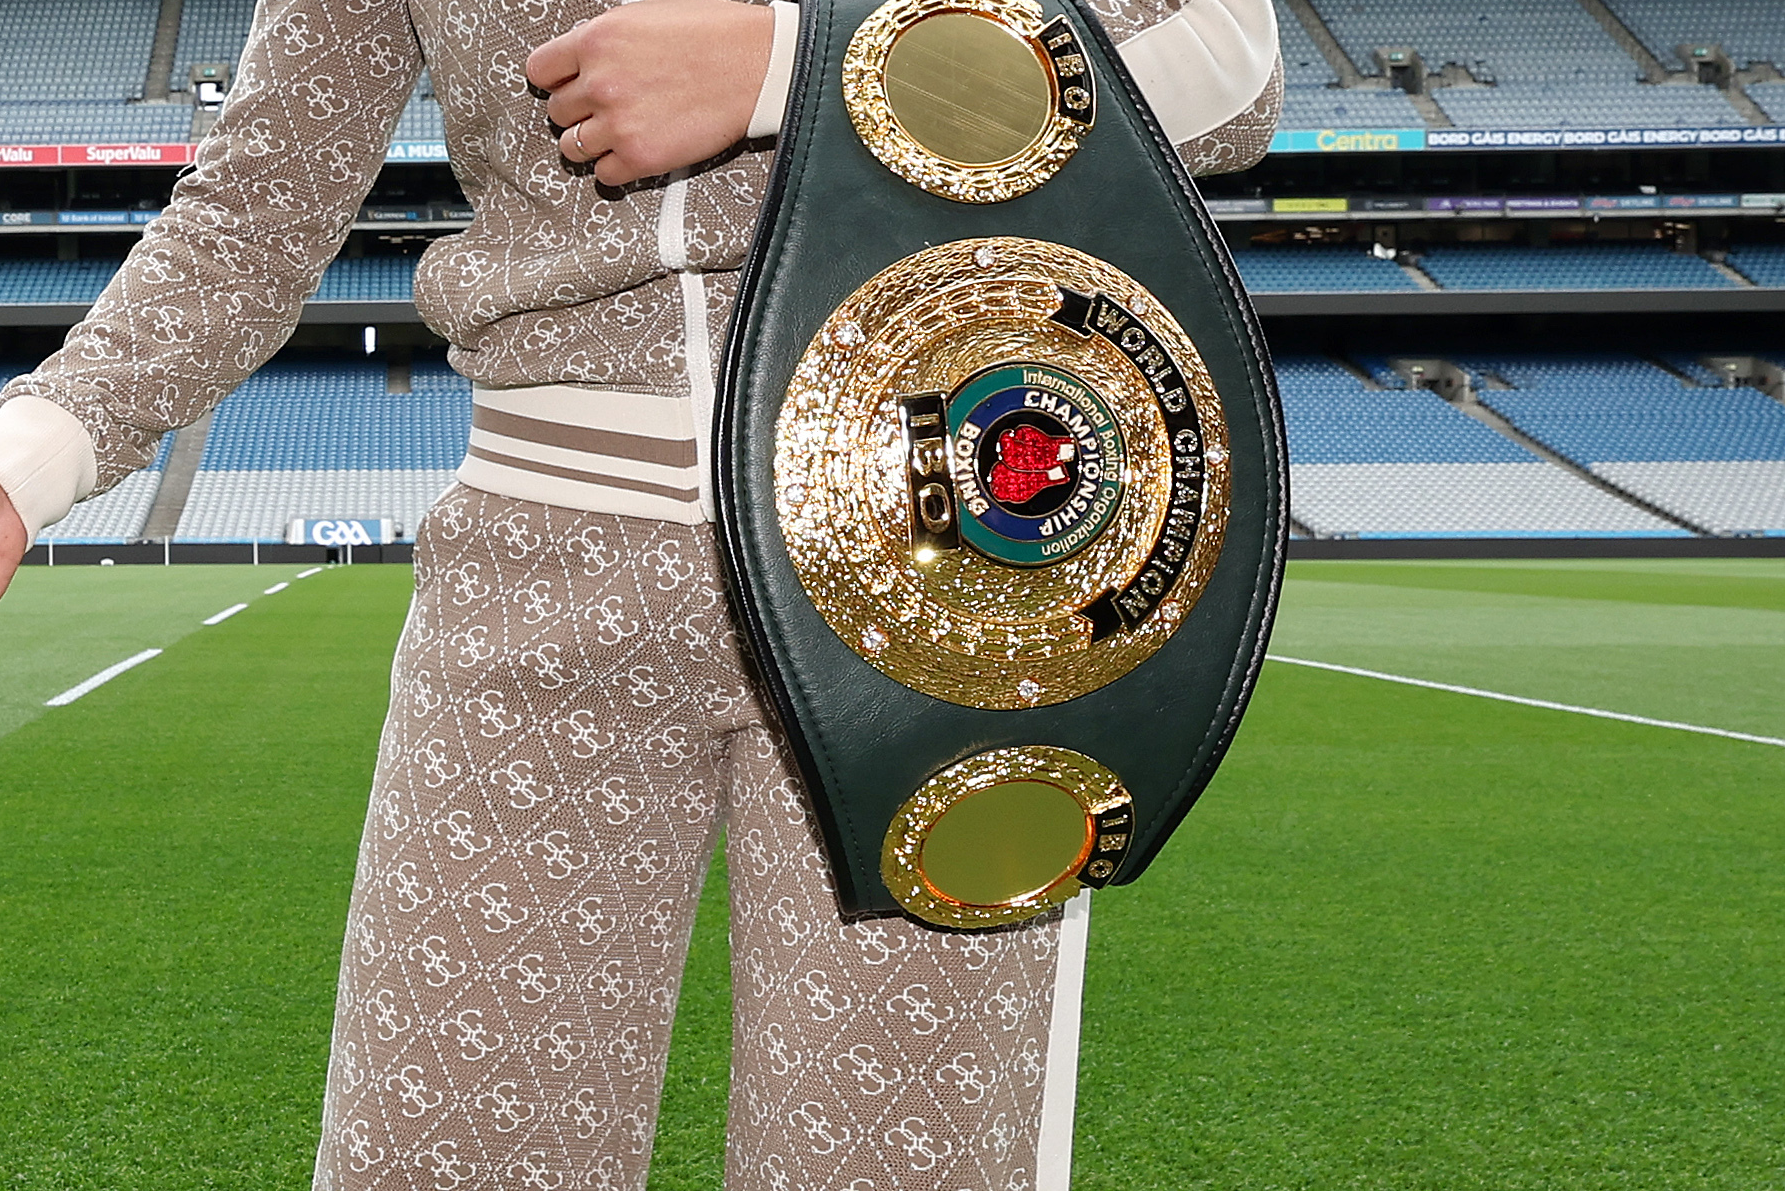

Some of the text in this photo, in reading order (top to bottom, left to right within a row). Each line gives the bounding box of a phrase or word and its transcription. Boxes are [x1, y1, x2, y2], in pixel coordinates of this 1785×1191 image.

[1317, 129, 1399, 151] Centra
[1428, 132, 1469, 145] BORD
[1507, 132, 1562, 145] ENERGY
[1565, 132, 1605, 144] BORD
[1643, 130, 1698, 143] ENERGY
[1699, 129, 1742, 142] BORD
[86, 145, 161, 165] SuperValu
[2, 212, 32, 223] CORE
[71, 213, 88, 222] Bank
[955, 421, 990, 518] BOXING
[1022, 369, 1119, 556] International Boxing Organization
[1024, 390, 1100, 537] CHAMPIONSHIP
[1096, 300, 1201, 619] WORLD CHAMPION
[909, 412, 951, 534] IBO
[312, 520, 373, 545] GAA
[1088, 813, 1128, 879] IBO
